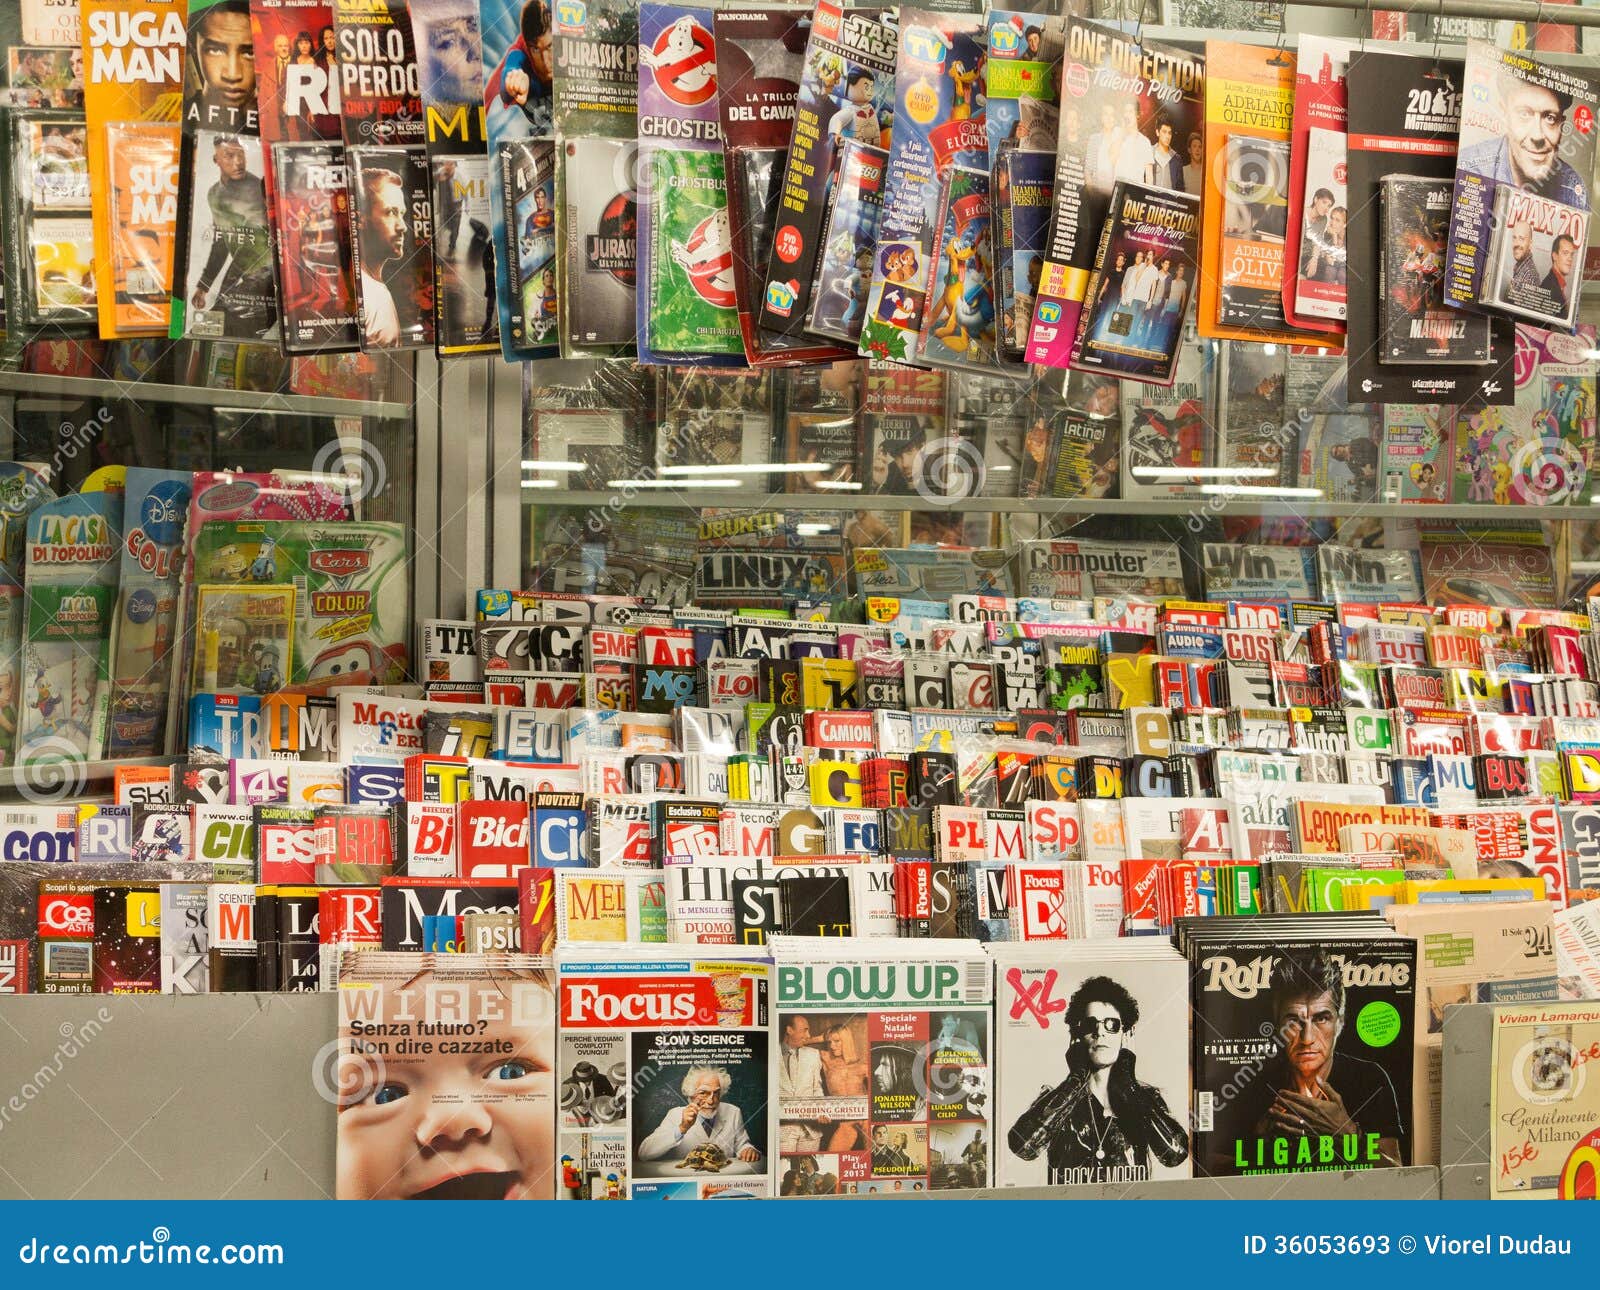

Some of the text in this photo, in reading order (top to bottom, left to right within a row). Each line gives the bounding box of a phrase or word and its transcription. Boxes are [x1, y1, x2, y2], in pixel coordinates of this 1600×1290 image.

[337, 15, 394, 25] PANORAMA
[558, 6, 585, 23] TV
[717, 13, 769, 21] PANORAMA
[816, 11, 838, 29] LEGO
[89, 11, 186, 47] SUGA
[843, 14, 898, 44] STAR
[340, 28, 404, 63] SOLO
[842, 33, 898, 62] WARS
[993, 30, 1017, 50] TV
[559, 42, 624, 67] JURASSIC
[907, 36, 943, 61] TV
[91, 48, 181, 84] MAN
[1070, 25, 1206, 94] ONE DIRECTION
[342, 63, 421, 97] PERDO
[567, 67, 615, 80] ULTIMATE
[591, 87, 617, 95] COMPLETA
[1093, 67, 1183, 104] Talento Puro
[566, 93, 628, 103] INCREDIBILI CONTENUTI
[746, 92, 799, 102] LA TRILOG
[578, 103, 608, 112] COFANETTO
[728, 105, 796, 121] DEL CAVA
[1224, 94, 1293, 117] ADRIANO
[187, 102, 258, 128] AFTE
[1224, 109, 1292, 130] OLIVETTI
[1315, 111, 1331, 119] PRIMA
[641, 116, 725, 140] GHOSTBU
[669, 176, 728, 191] GHOSTBUS
[1012, 186, 1043, 197] MAMMA
[1123, 199, 1145, 220] ONE
[1146, 203, 1200, 235] DIRECTION
[1507, 193, 1586, 250] MAX 20
[784, 231, 796, 243] DVD
[1134, 221, 1187, 241] Talento Puro
[202, 232, 256, 246] AFTER
[1235, 244, 1284, 261] ADRIAN
[768, 291, 791, 308] TV
[1039, 304, 1061, 322] TV
[1410, 319, 1467, 339] MARQUEZ
[1064, 420, 1107, 441] latino!
[40, 514, 110, 546] LA CASA
[700, 511, 778, 541] UBUNTU
[32, 545, 113, 563] DI TOPOLINO
[316, 551, 364, 570] Cars
[1030, 549, 1148, 575] Computer
[702, 555, 809, 589] LINUX
[1235, 578, 1275, 589] Magazine
[315, 593, 367, 614] COLOR
[675, 611, 706, 620] BENVENUTI
[959, 601, 1012, 624] Com
[1449, 612, 1488, 628] VERO
[763, 620, 793, 628] LENOVO
[1165, 623, 1205, 633] 3 RIVISTE
[1030, 626, 1083, 638] VIDEOCORSI
[1167, 635, 1205, 649] AUDIO
[1226, 632, 1274, 662] COS
[429, 682, 484, 691] DELTOIDI MASSICCI
[488, 675, 513, 684] FITNESS
[1396, 675, 1445, 697] MOTOC
[219, 697, 235, 705] 2013
[818, 719, 872, 743] CAMION
[143, 803, 180, 812] RODRIGUEZ
[537, 793, 581, 807] NOVITÀ!
[668, 806, 702, 817] Esclusivo
[739, 814, 774, 825] tecno
[472, 816, 528, 848] Bici
[1476, 812, 1496, 859] 2013
[1361, 831, 1464, 865] POESIA 288
[45, 884, 69, 893] Scopri
[1024, 874, 1060, 889] Focus
[916, 867, 928, 917] Focus
[687, 907, 717, 915] MENSILE
[685, 922, 733, 934] DUOMO
[1509, 928, 1524, 937] Sole
[702, 936, 722, 945] Apre
[778, 965, 960, 1001] BLOW UP.
[1202, 954, 1274, 1000] Roll
[45, 983, 92, 993] 50 anni fa
[341, 983, 553, 1027] WIRED
[566, 984, 697, 1022] Focus
[1006, 967, 1067, 1030] XL
[880, 1014, 917, 1025] Speciale
[1500, 1011, 1600, 1025] Vivian Lamarqu
[350, 1019, 488, 1037] Senza futuro?
[884, 1024, 913, 1033] Natale
[592, 1035, 624, 1043] VEDIAMO
[655, 1034, 745, 1047] SLOW SCIENCE
[894, 1032, 915, 1041] pagine!
[350, 1038, 514, 1055] Non dire cazzate
[573, 1042, 613, 1050] COMPLOTTI
[1204, 1043, 1278, 1056] FRANK ZAPPA
[874, 1095, 916, 1104] JONATHAN
[879, 1102, 911, 1110] WILSON
[783, 1106, 865, 1115] THROBBING GRISTLE
[931, 1104, 963, 1112] LUCIANO
[937, 1110, 957, 1119] CILIO
[1501, 1107, 1599, 1133] Gentilmente
[1527, 1127, 1581, 1144] Milano
[602, 1143, 625, 1152] Nella
[1235, 1133, 1381, 1168] LIGABUE
[589, 1151, 626, 1161] fabbrica
[842, 1155, 859, 1165] Play
[589, 1159, 626, 1170] del Lego
[852, 1162, 867, 1171] List
[873, 1165, 920, 1174] PSEUDOFILM
[843, 1169, 865, 1179] 2013
